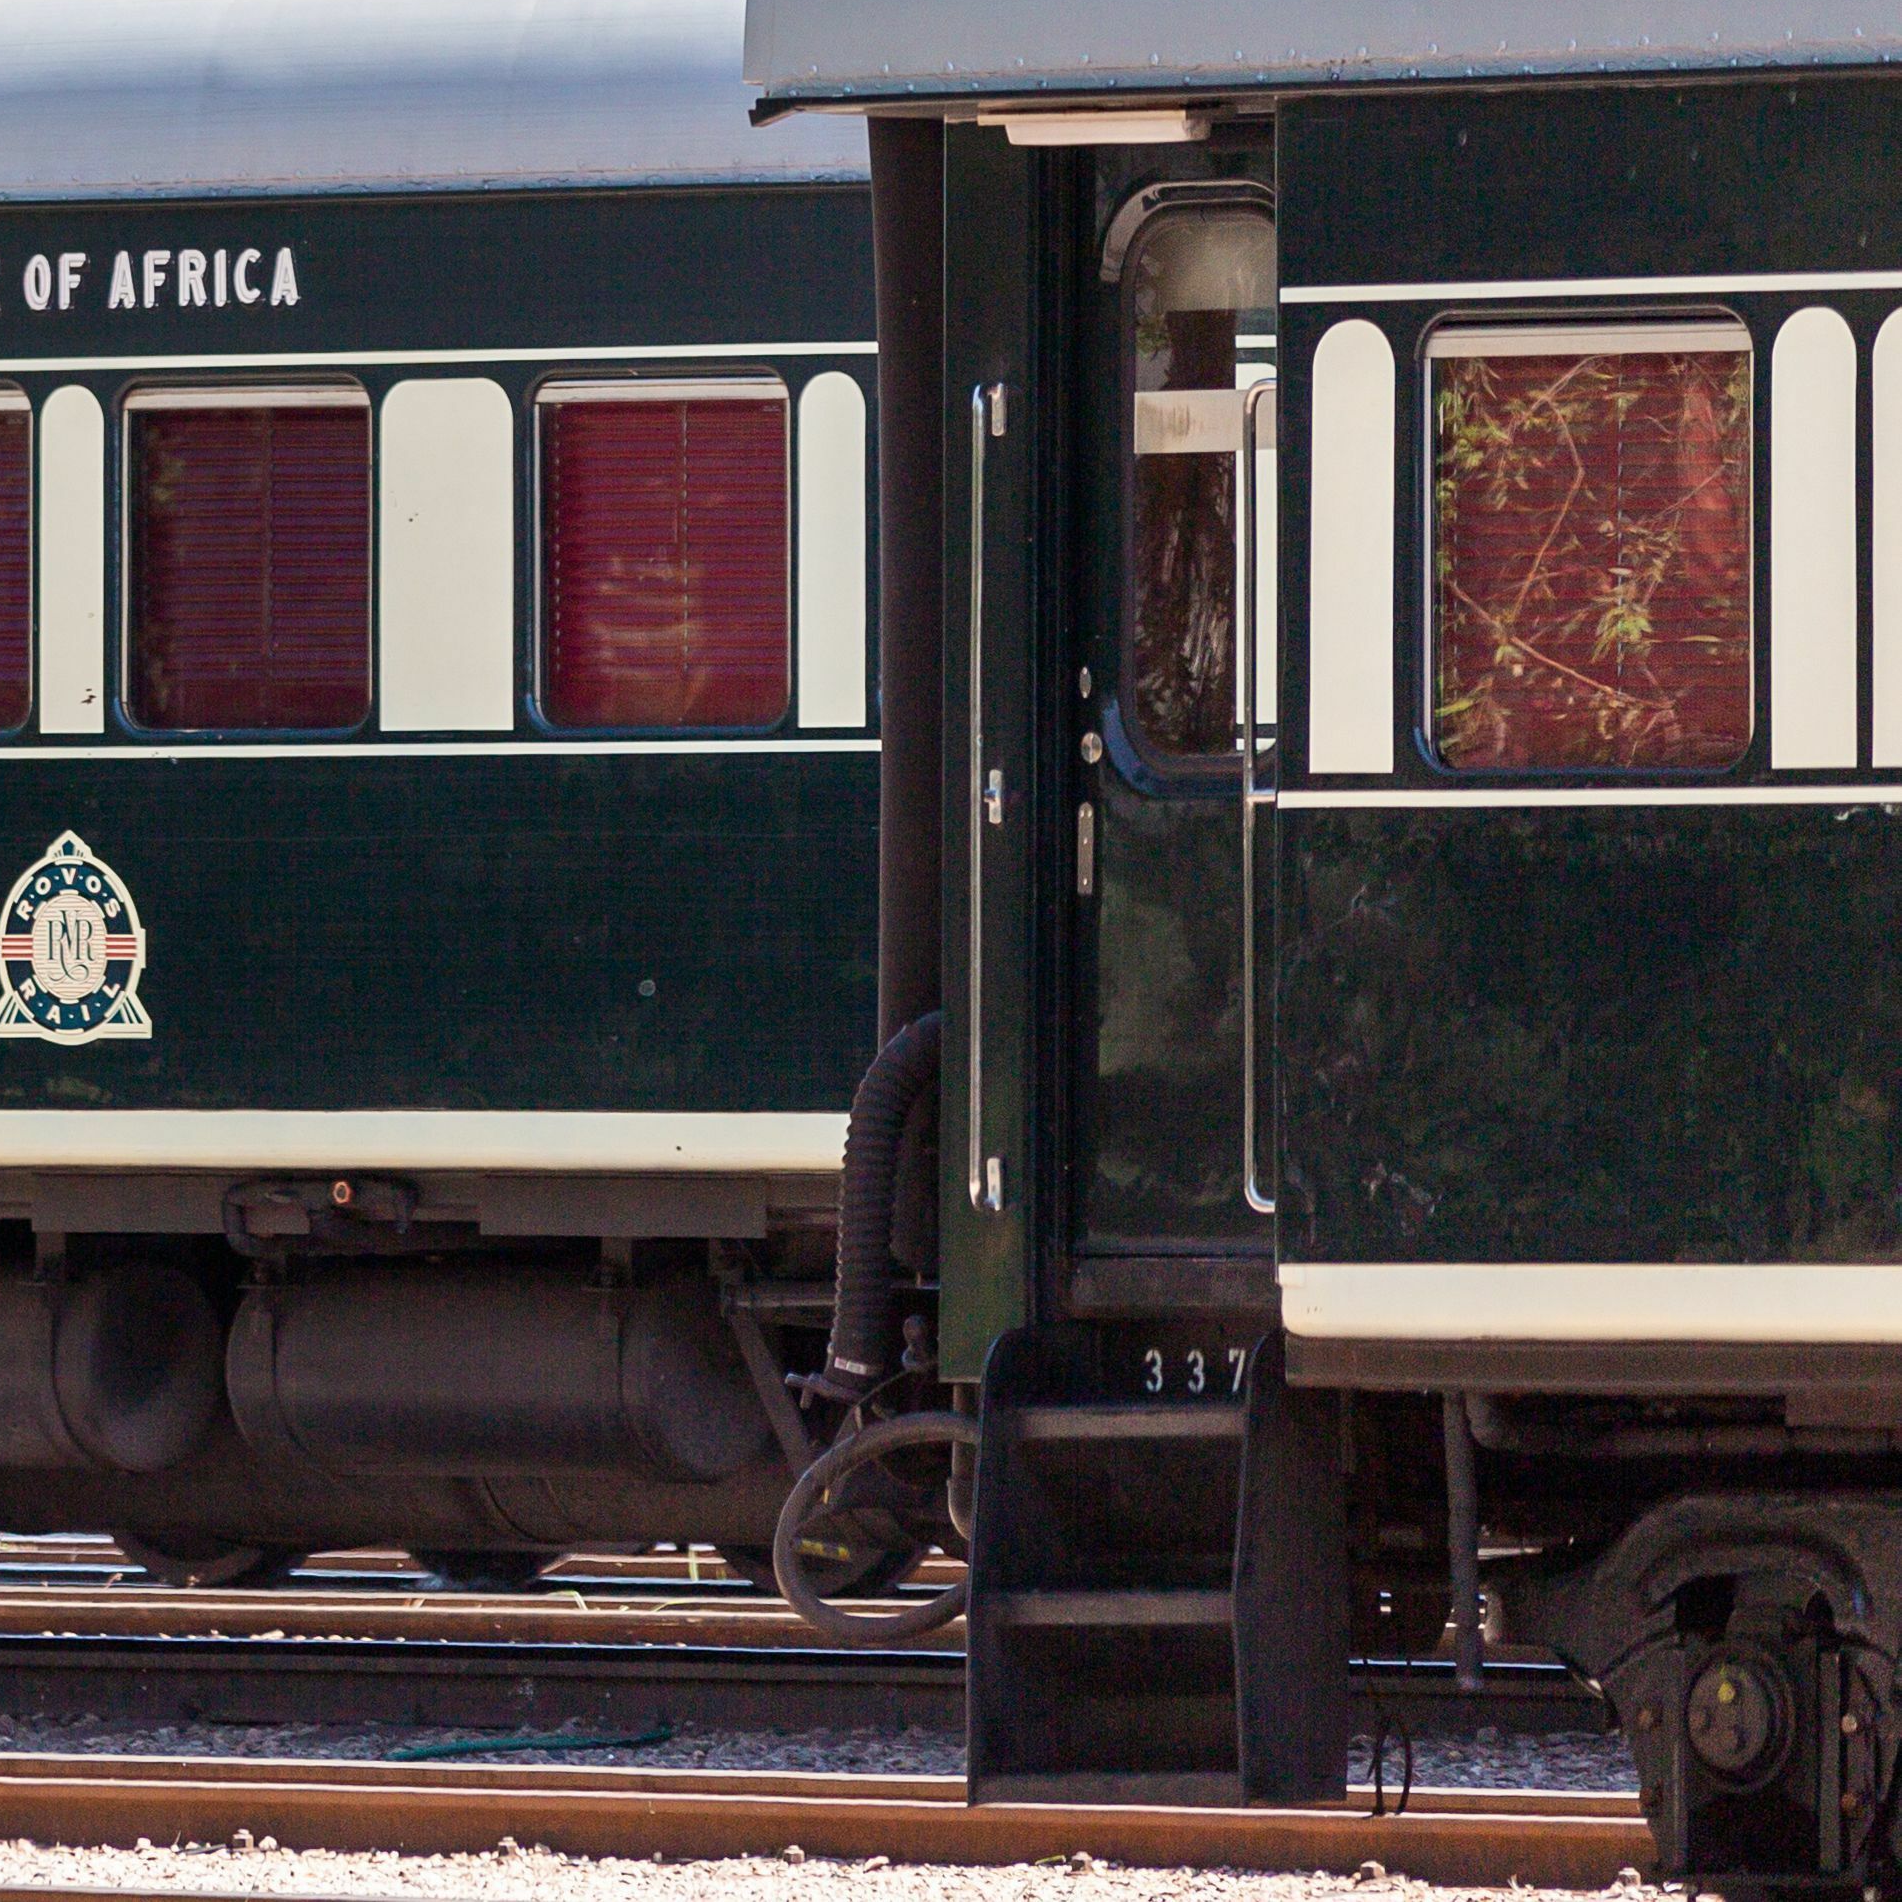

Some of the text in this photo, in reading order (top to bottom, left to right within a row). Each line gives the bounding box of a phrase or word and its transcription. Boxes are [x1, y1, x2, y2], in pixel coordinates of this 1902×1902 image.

[23, 252, 87, 313] OF
[107, 247, 300, 310] AFRICA
[1145, 1348, 1246, 1393] 337
